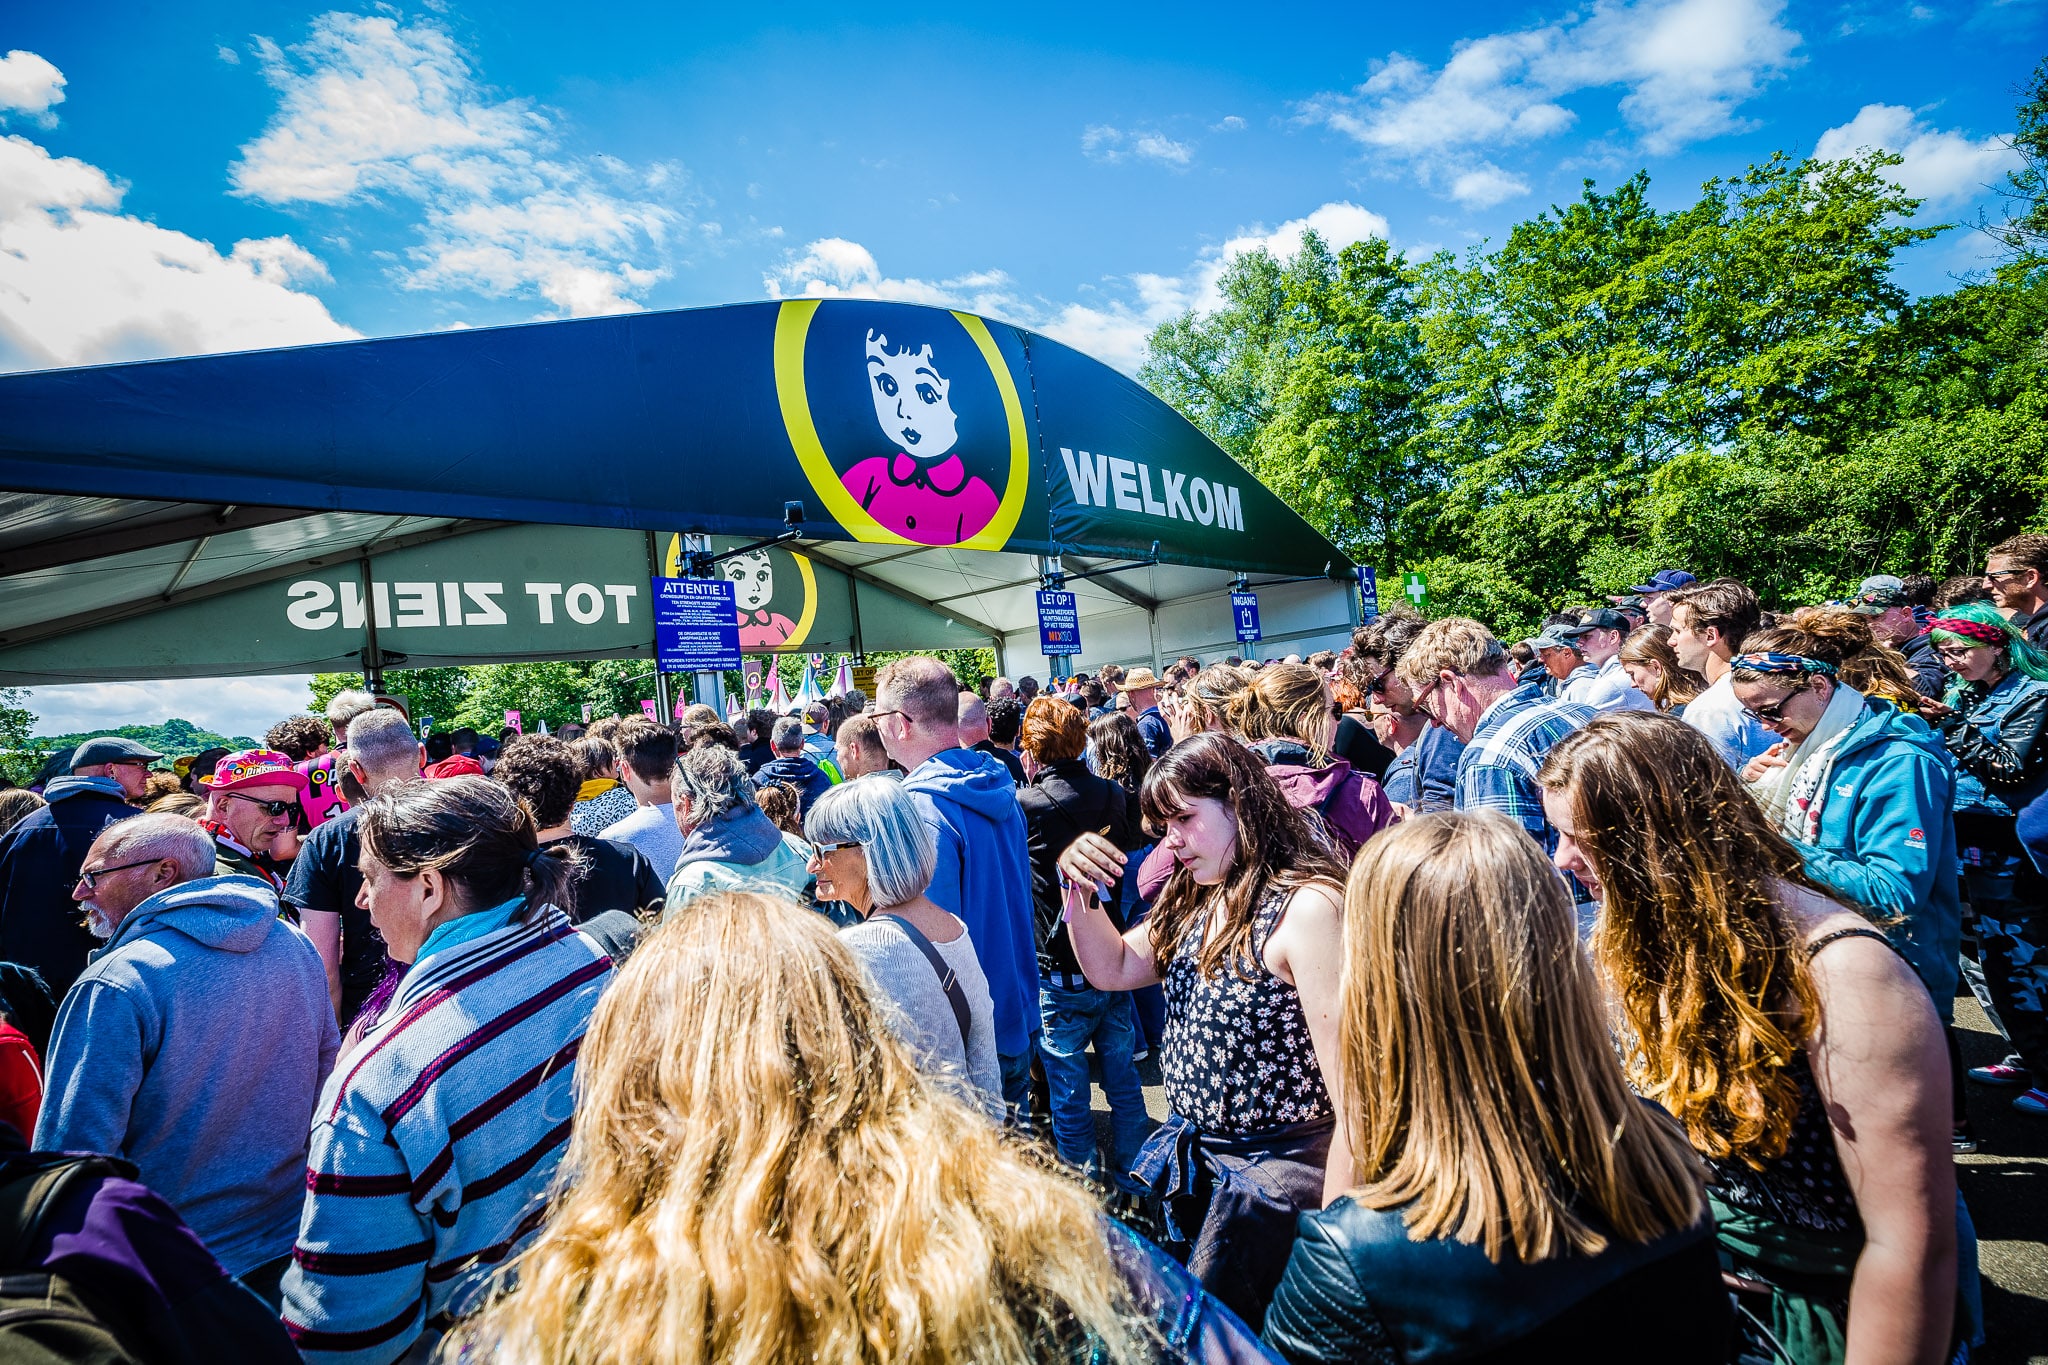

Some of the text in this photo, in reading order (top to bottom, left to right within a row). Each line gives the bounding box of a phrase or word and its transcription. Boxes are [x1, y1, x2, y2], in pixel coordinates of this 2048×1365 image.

[1060, 447, 1245, 532] WELKOM
[663, 582, 726, 595] ATTENTIE !
[1041, 594, 1072, 606] LET OP !
[1232, 596, 1256, 606] INGANG
